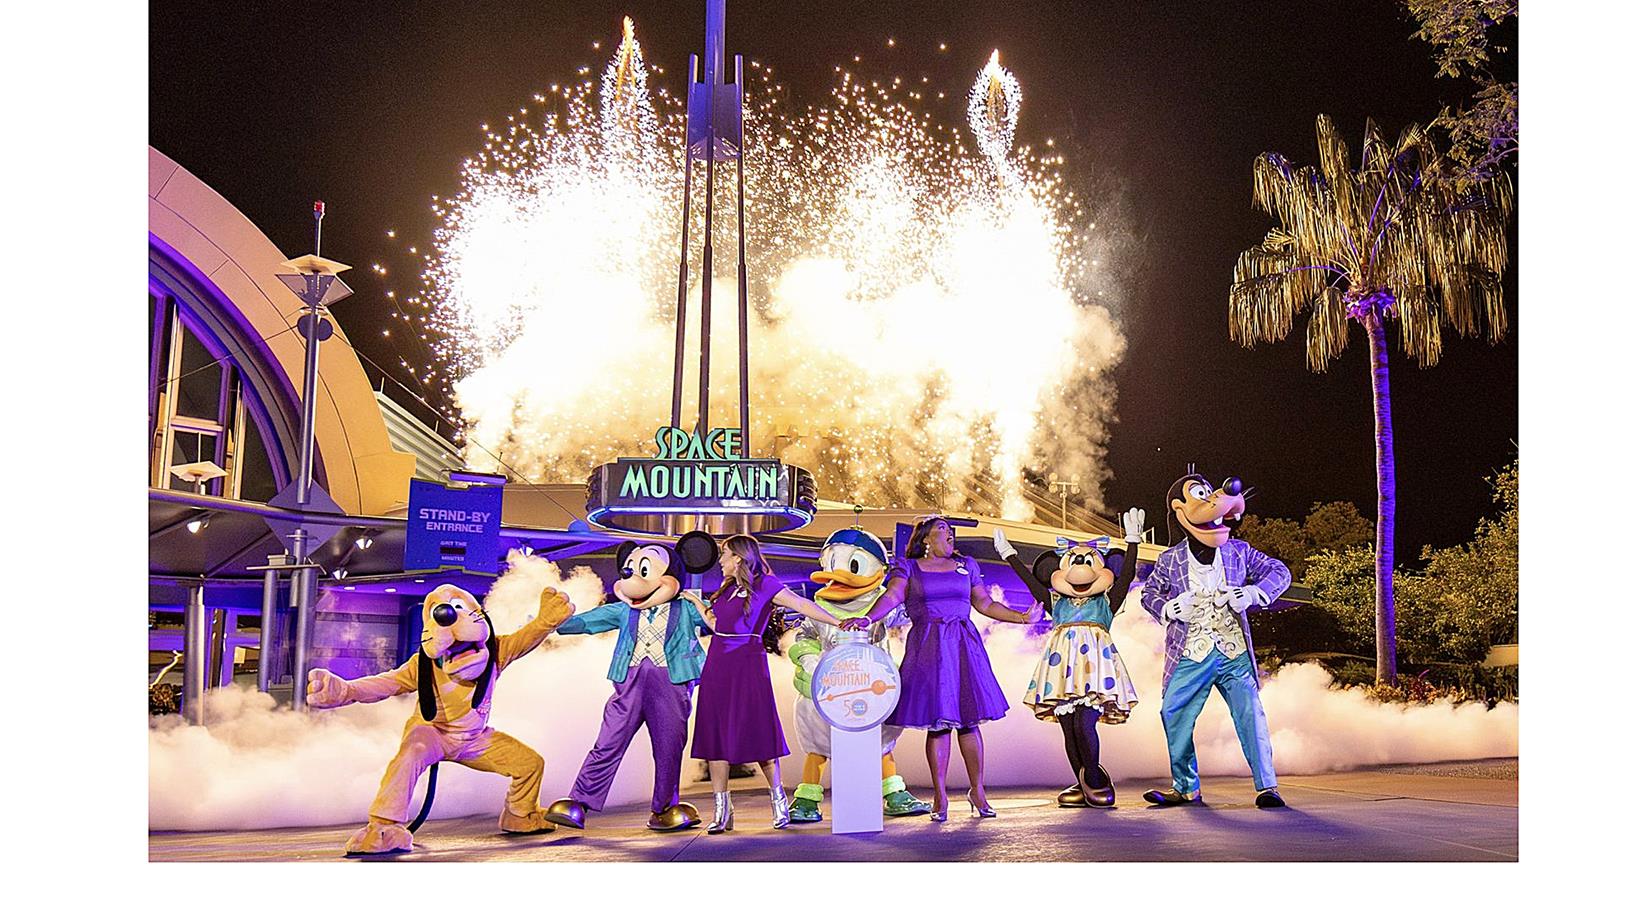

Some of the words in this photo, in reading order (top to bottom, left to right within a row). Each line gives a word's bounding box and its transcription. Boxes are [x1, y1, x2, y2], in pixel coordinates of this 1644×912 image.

[655, 426, 742, 460] SPACE
[619, 464, 777, 498] MOUNTAIN
[419, 508, 490, 522] STAND-BY
[426, 522, 483, 533] ENTRANCE
